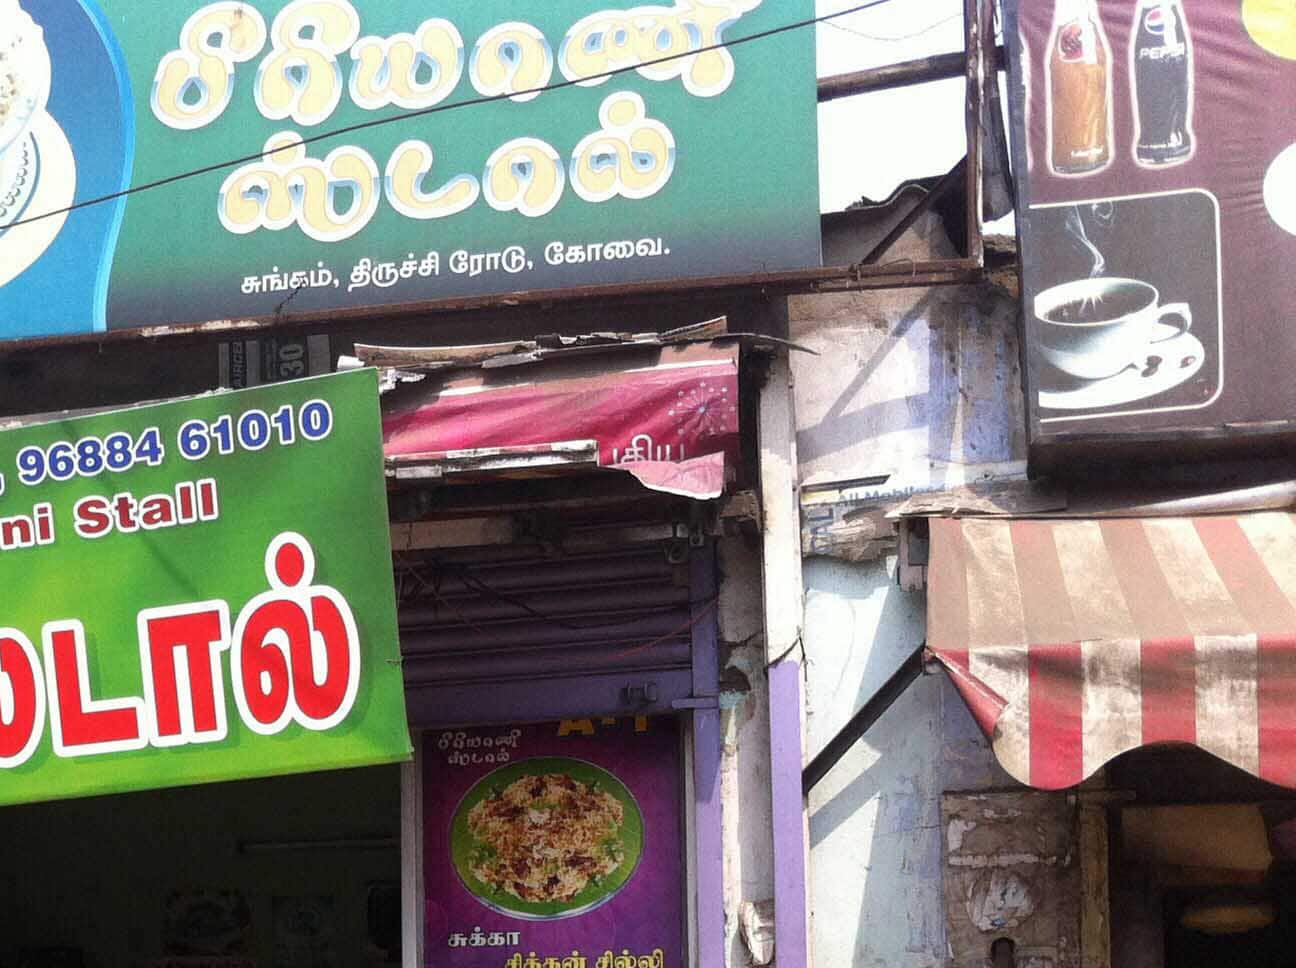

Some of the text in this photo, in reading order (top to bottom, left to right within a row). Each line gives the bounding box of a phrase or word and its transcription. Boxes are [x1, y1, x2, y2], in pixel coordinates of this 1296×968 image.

[217, 90, 676, 242] ஸ்டால்
[347, 251, 440, 292] திருச்சி
[449, 245, 534, 277] ரோடு,
[544, 237, 671, 266] கோவை.
[18, 428, 165, 484] 96884
[179, 399, 333, 460] 61010
[74, 477, 219, 538] Stall
[448, 926, 520, 947] சுக்கா
